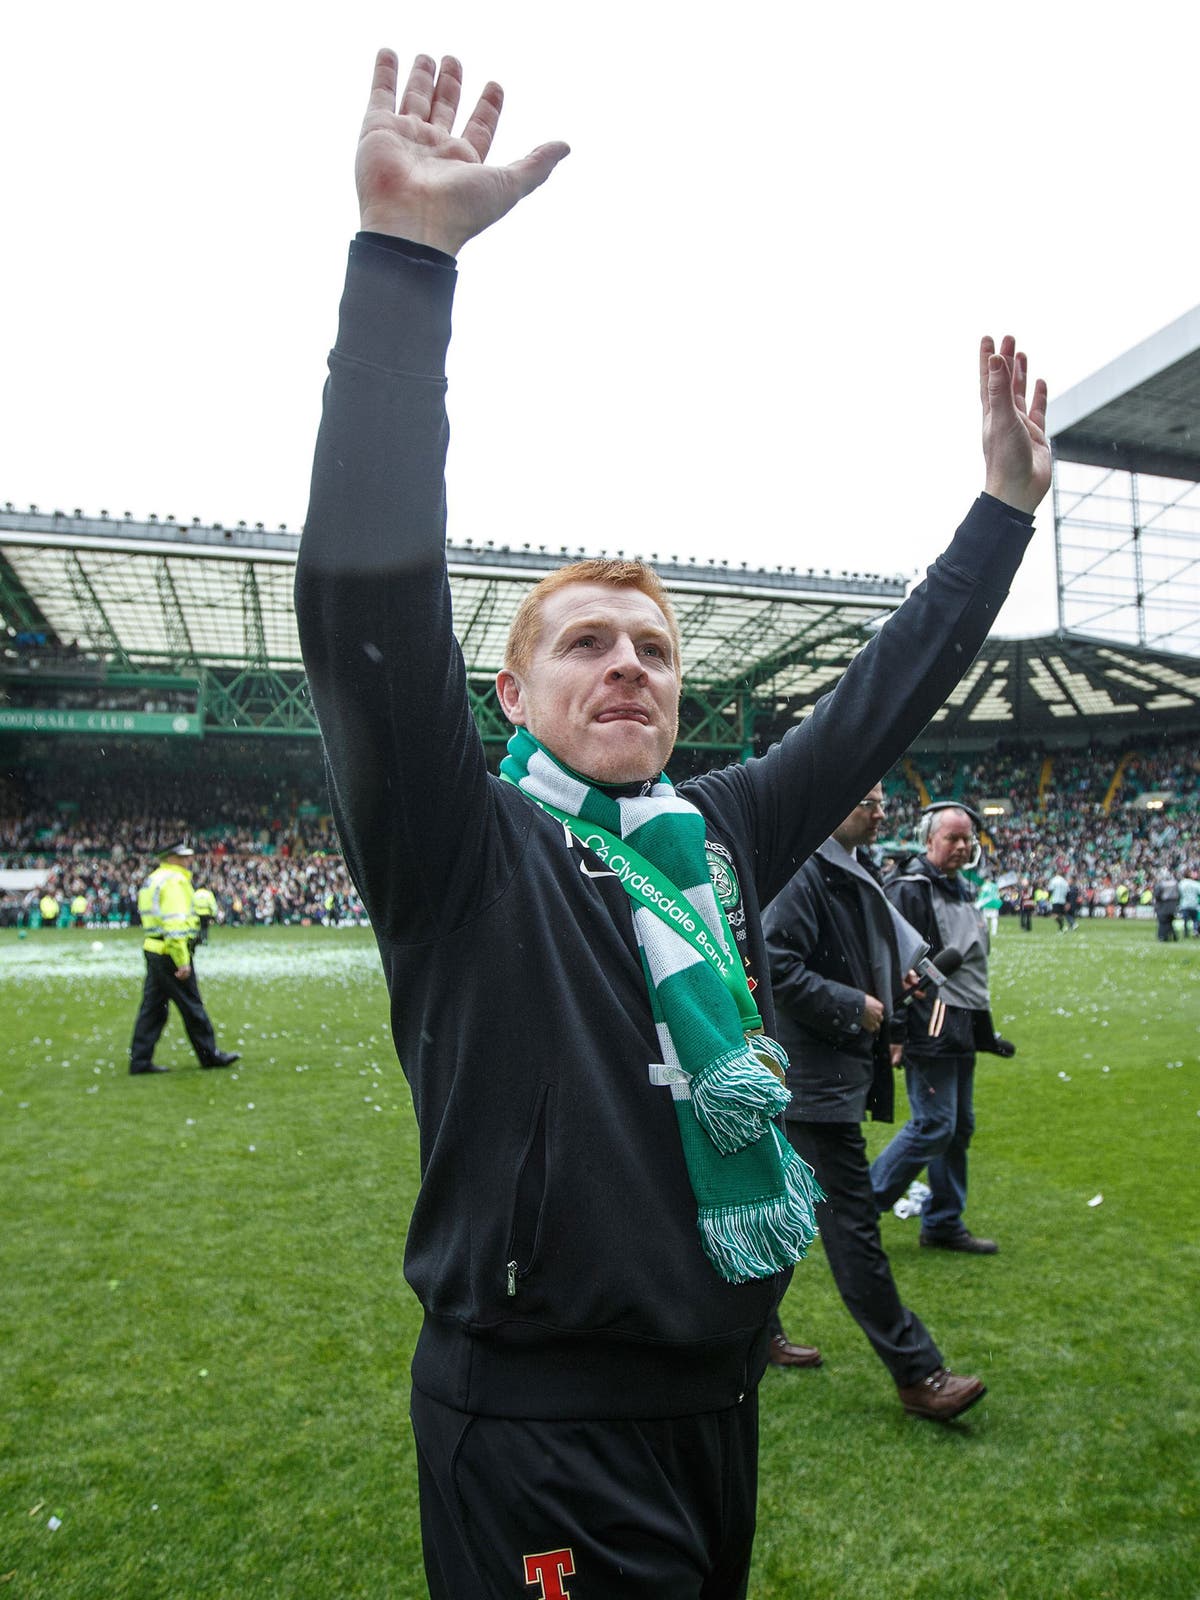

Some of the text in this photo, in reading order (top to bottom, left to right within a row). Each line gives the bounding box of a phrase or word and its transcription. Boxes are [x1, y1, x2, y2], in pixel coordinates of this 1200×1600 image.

[0, 712, 135, 729] OOTBALL CLUB
[608, 855, 728, 977] Clydesdale Bank
[523, 1548, 576, 1600] T
